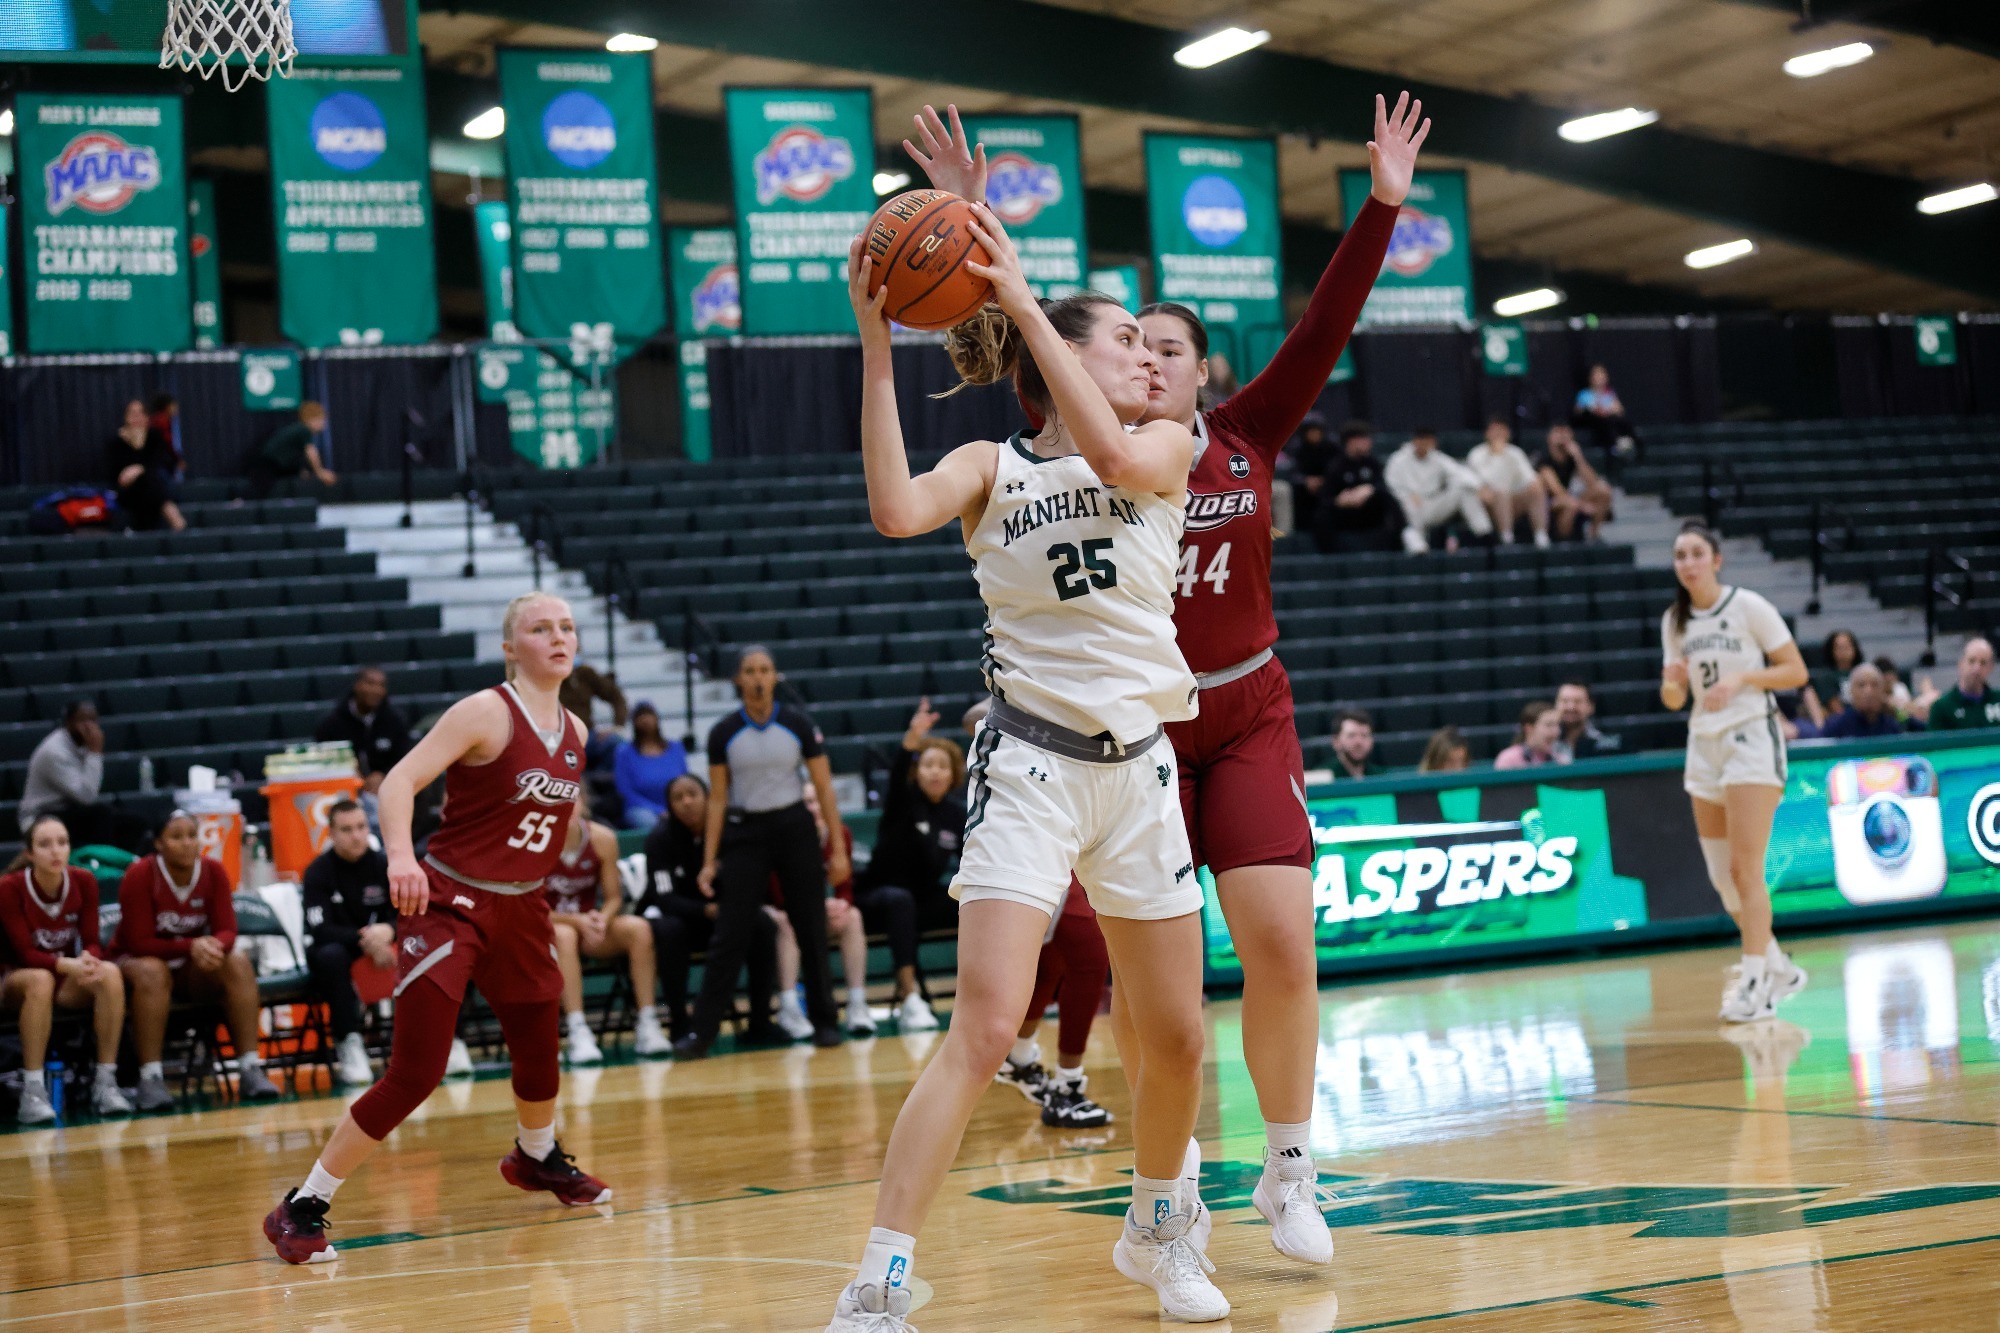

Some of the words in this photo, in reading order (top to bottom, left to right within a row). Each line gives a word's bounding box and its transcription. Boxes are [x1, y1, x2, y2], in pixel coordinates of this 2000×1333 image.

[550, 126, 616, 151] NCAA
[48, 148, 158, 211] MAAC
[34, 225, 177, 247] TOURNAMENT
[37, 248, 178, 275] CHAMPIONS
[1230, 461, 1249, 471] BLM
[1003, 487, 1145, 547] MANHATAN
[1046, 538, 1117, 601] 25
[1176, 542, 1231, 597] 44
[507, 811, 558, 853] 55
[1313, 836, 1577, 923] ASPERS
